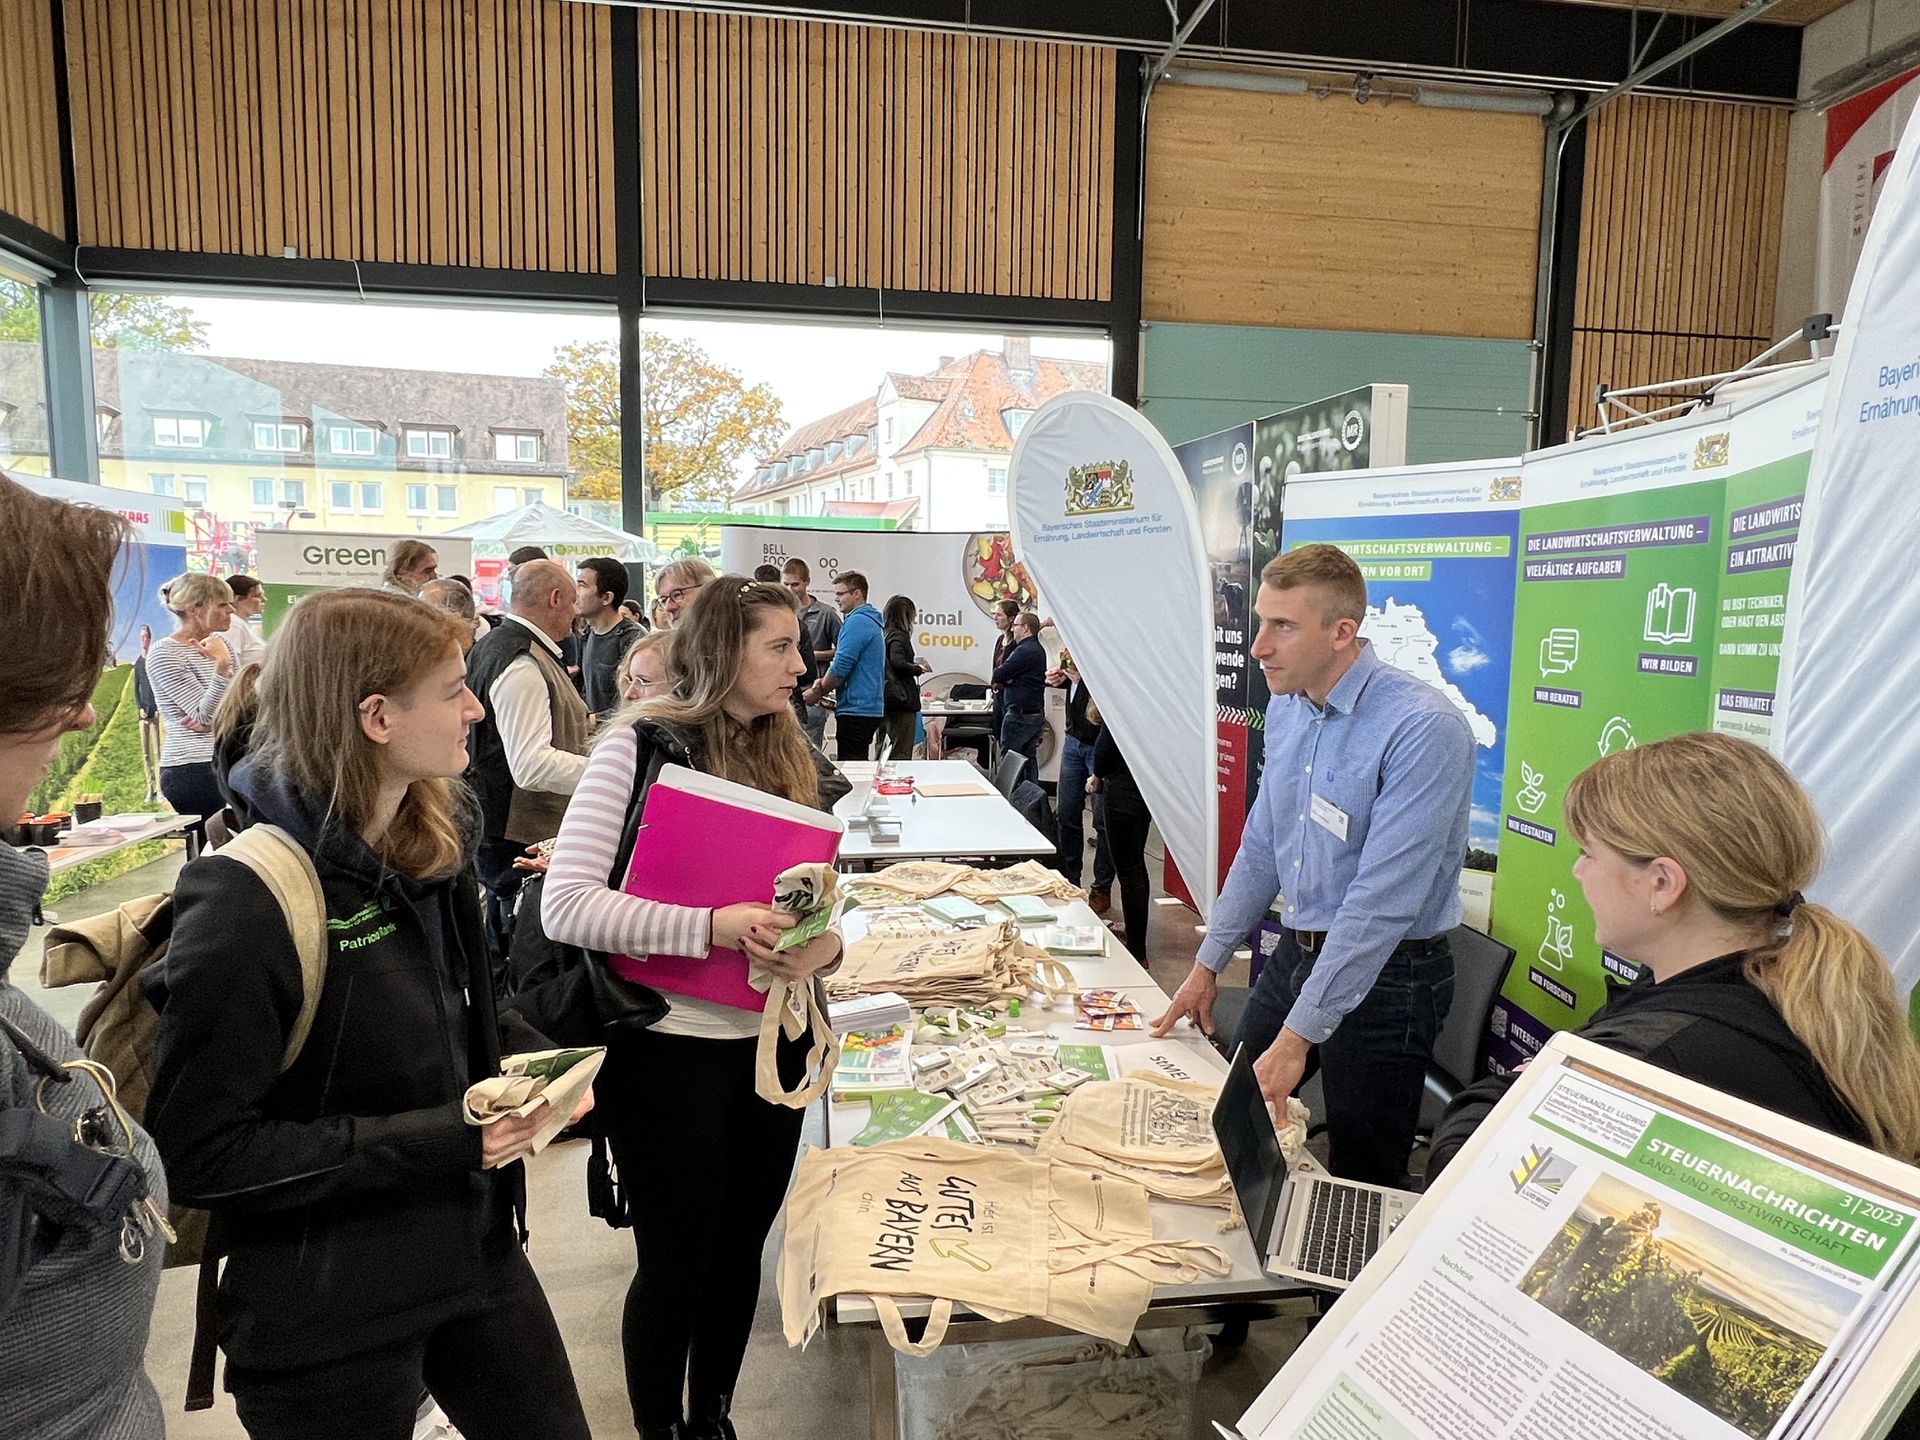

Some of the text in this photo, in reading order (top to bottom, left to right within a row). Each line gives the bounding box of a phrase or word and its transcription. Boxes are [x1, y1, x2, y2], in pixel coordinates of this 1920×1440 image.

[1651, 468, 1663, 477] und
[1441, 495, 1455, 504] und
[1041, 513, 1163, 533] Bayerisches Staatsministerium für
[1733, 502, 1802, 533] DIE LANDWIRTS
[1071, 527, 1125, 540] Landwirtschaft
[1126, 526, 1141, 535] und
[1143, 524, 1172, 534] Forsten
[1528, 524, 1694, 551] DIE LANDWIRTSCHAFTSVERWALTUNG
[303, 545, 386, 566] Green
[763, 543, 787, 555] BELL
[1338, 540, 1492, 555] WIRTSCHAFTSVERWALTUNG
[1730, 541, 1798, 568] EIN ATTRAKTIV
[1379, 566, 1401, 577] VOR
[1403, 565, 1425, 577] ORT
[1526, 559, 1622, 577] VIELFÄLTIGE AUFGABEN
[1722, 599, 1732, 611] DU
[1732, 598, 1746, 611] BIST
[1721, 613, 1785, 629] ODER HAST DEN ABS
[918, 632, 979, 651] Group.
[1225, 629, 1243, 645] uns
[1719, 643, 1736, 655] DANN
[1737, 643, 1757, 656] KOMM
[1758, 643, 1768, 656] ZU
[1641, 657, 1693, 673] WIR BILDEN
[1535, 690, 1579, 706] WIR BERATEN
[1720, 694, 1735, 708] DAS
[1735, 694, 1770, 712] ERWARTET
[1508, 818, 1554, 843] WIR GESTALTEN
[1604, 954, 1619, 972] WIR
[1531, 969, 1574, 1006] WIR FORSCHEN
[1556, 1084, 1616, 1113] STEUERKANZLEI
[1616, 1110, 1648, 1128] LUDWIG
[896, 1170, 923, 1196] AUS
[1646, 1138, 1888, 1251] STEUERNACHRICHTEN
[930, 1176, 978, 1233] GUTES
[1638, 1154, 1852, 1256] LAND- UND FORSTWIRTSCHAFT
[868, 1198, 929, 1272] BAYERN
[1440, 1253, 1474, 1281] Nachlese
